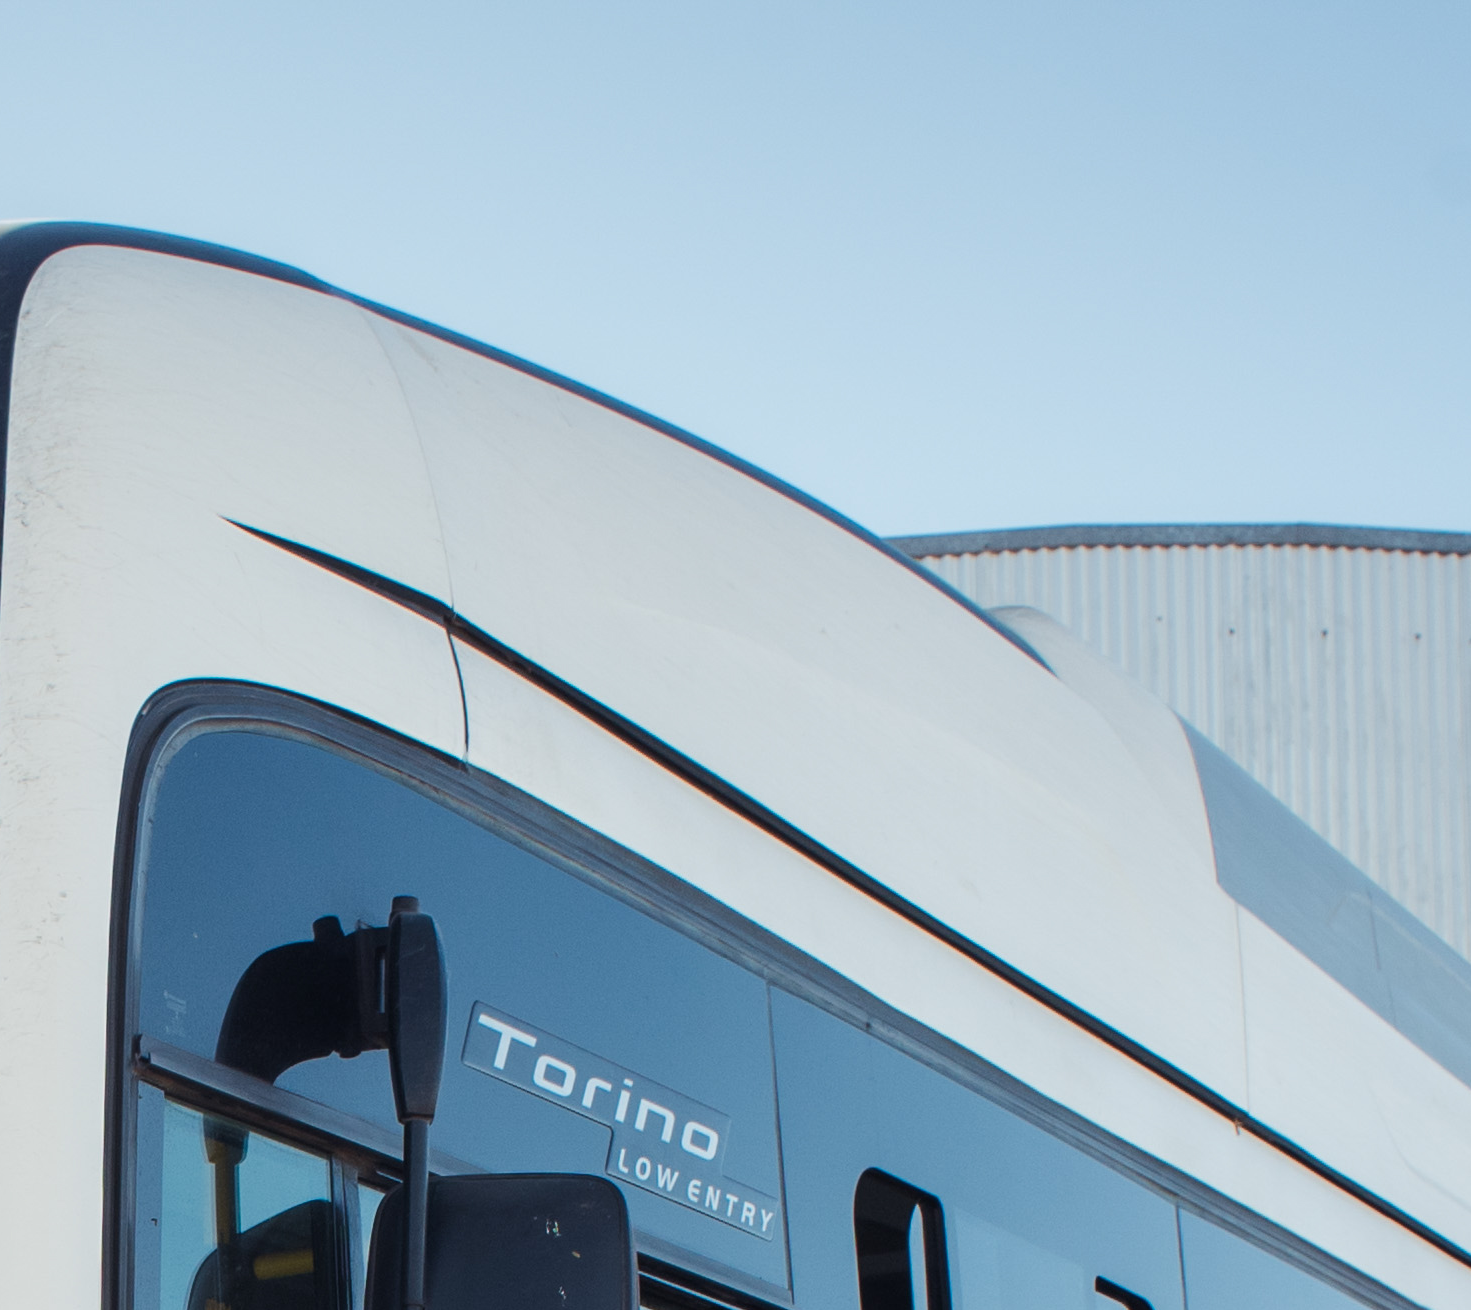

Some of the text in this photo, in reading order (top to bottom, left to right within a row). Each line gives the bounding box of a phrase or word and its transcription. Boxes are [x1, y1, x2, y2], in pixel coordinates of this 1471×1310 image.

[477, 1012, 720, 1161] Torino
[617, 1148, 774, 1233] LOW ENTRY
